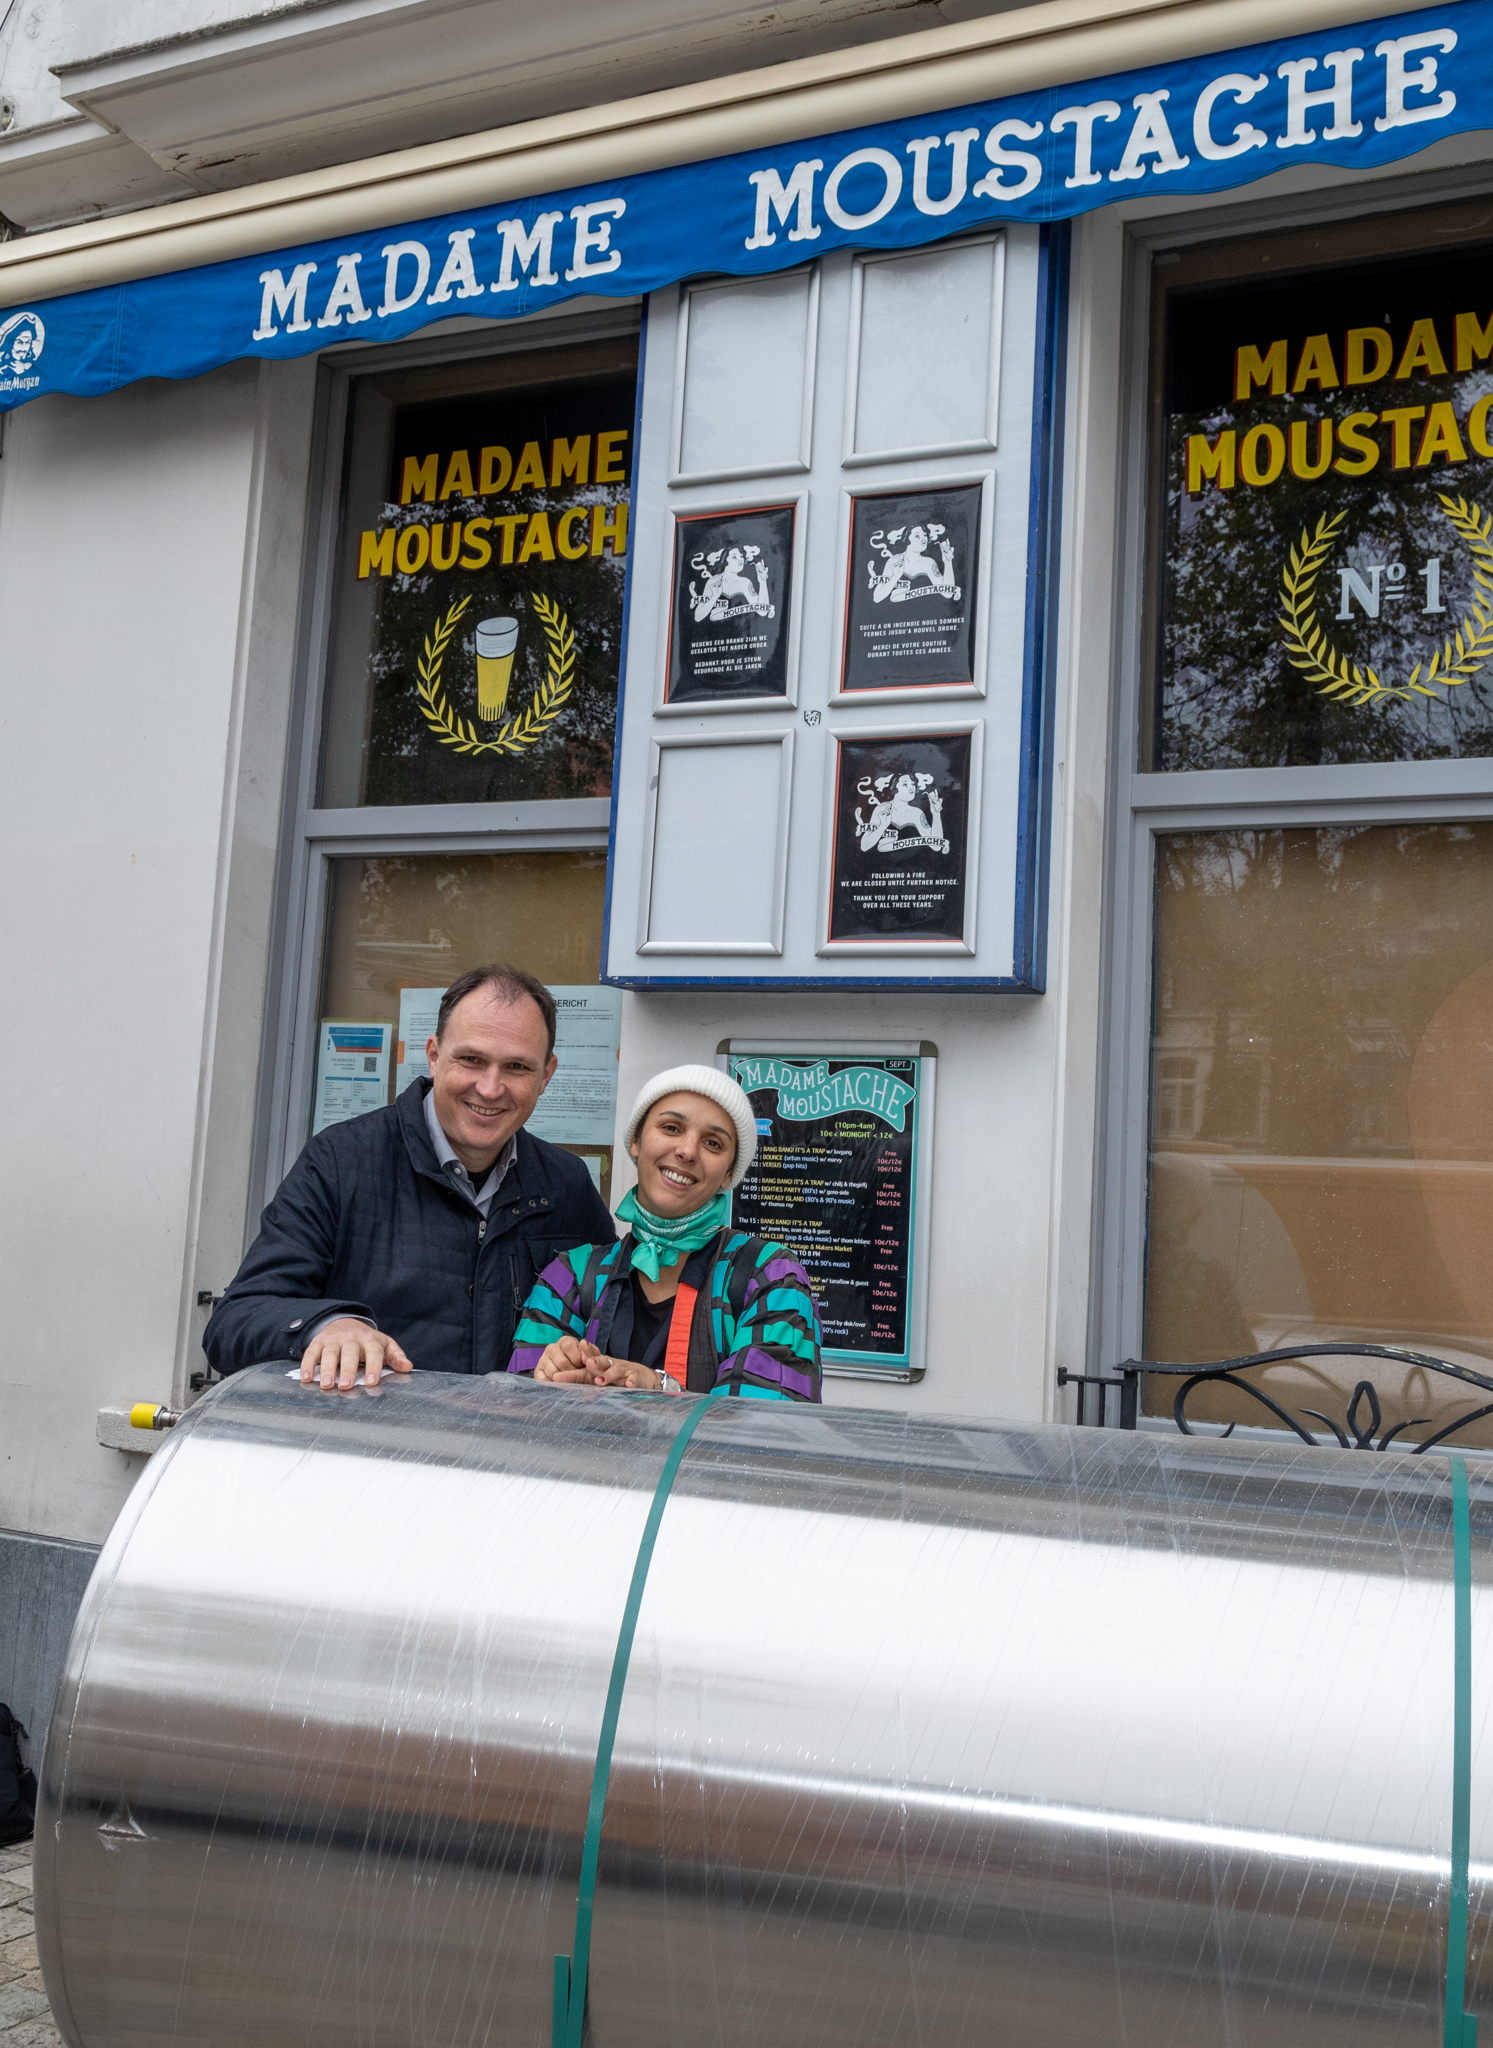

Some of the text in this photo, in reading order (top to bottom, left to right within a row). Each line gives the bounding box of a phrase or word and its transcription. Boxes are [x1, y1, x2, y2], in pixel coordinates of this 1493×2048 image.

[252, 28, 1458, 340] MADAME MOUSTACHE
[1233, 311, 1493, 402] MADAM
[1184, 393, 1493, 495] MOUSTAC
[400, 430, 628, 505] MADAME
[357, 503, 628, 580] MOUSTACH
[905, 586, 957, 599] MOUSTACHE
[1418, 558, 1447, 614] 1
[723, 604, 771, 618] MOUSTACHE
[691, 647, 717, 655] GESLOTEN
[692, 640, 712, 648] WEGENS
[694, 667, 725, 675] GEDURENDE
[695, 660, 719, 668] BEDANKT
[892, 838, 945, 850] MOUSTACHE
[889, 1060, 907, 1068] SEPT
[745, 1062, 826, 1091] MADAME
[783, 1072, 906, 1119] MOUSTACHE
[834, 1121, 876, 1130] (10pm-4am)
